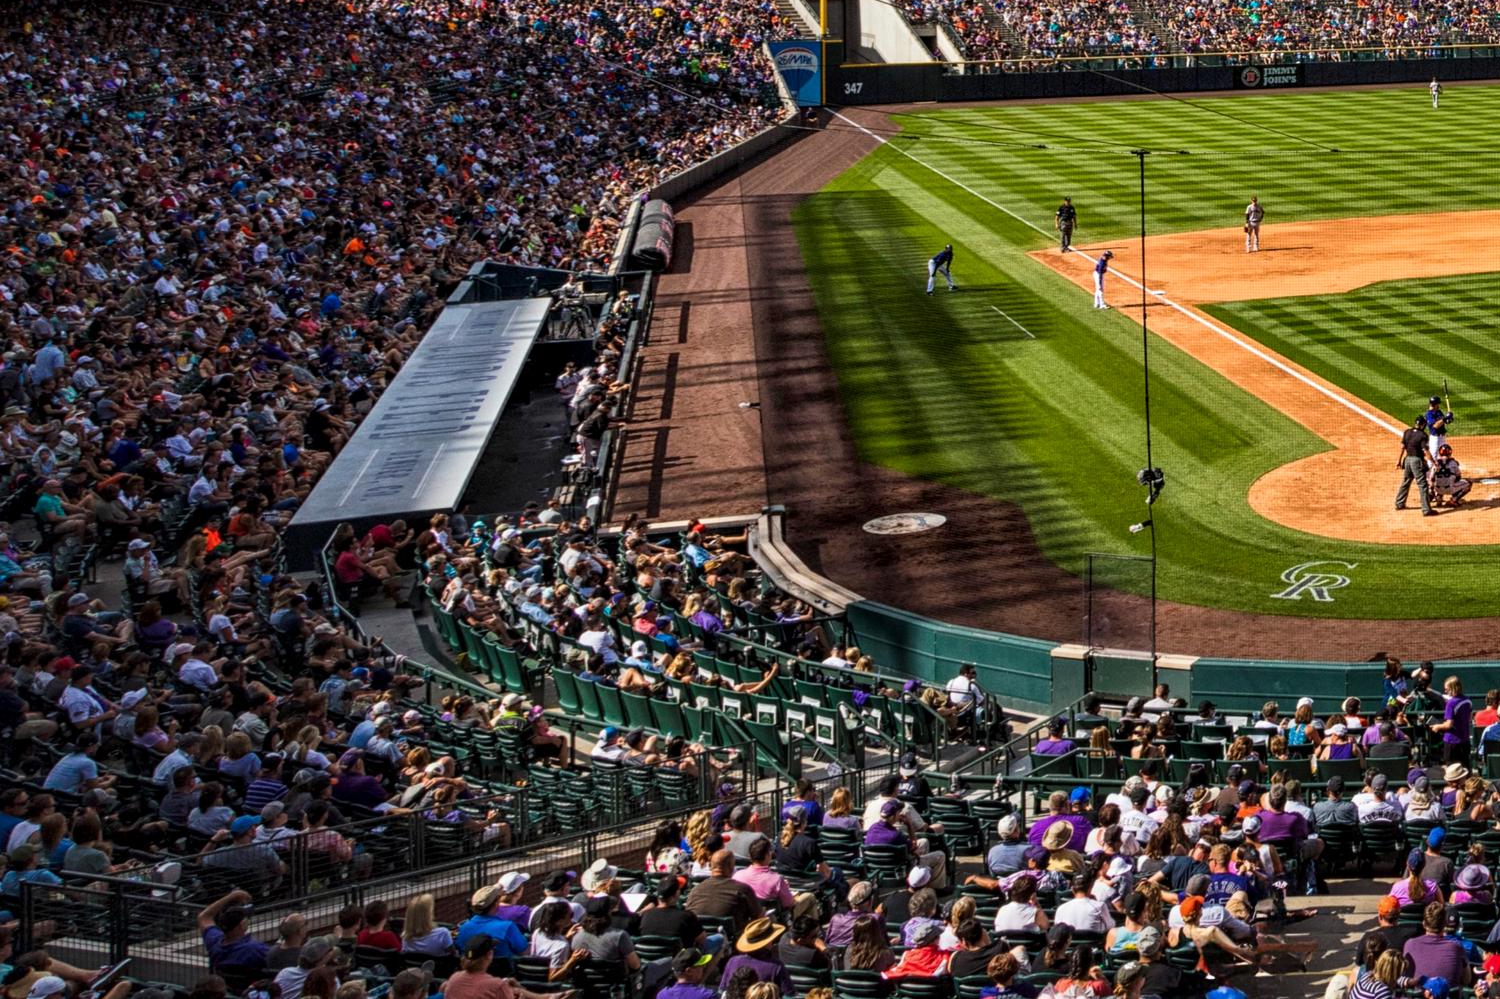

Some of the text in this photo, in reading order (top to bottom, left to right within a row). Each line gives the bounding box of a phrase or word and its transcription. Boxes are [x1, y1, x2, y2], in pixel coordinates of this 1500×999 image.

[1263, 67, 1296, 77] JIMMY
[1263, 75, 1296, 86] JOHN'S
[844, 82, 863, 94] 347
[368, 342, 514, 440] COORS FIELD
